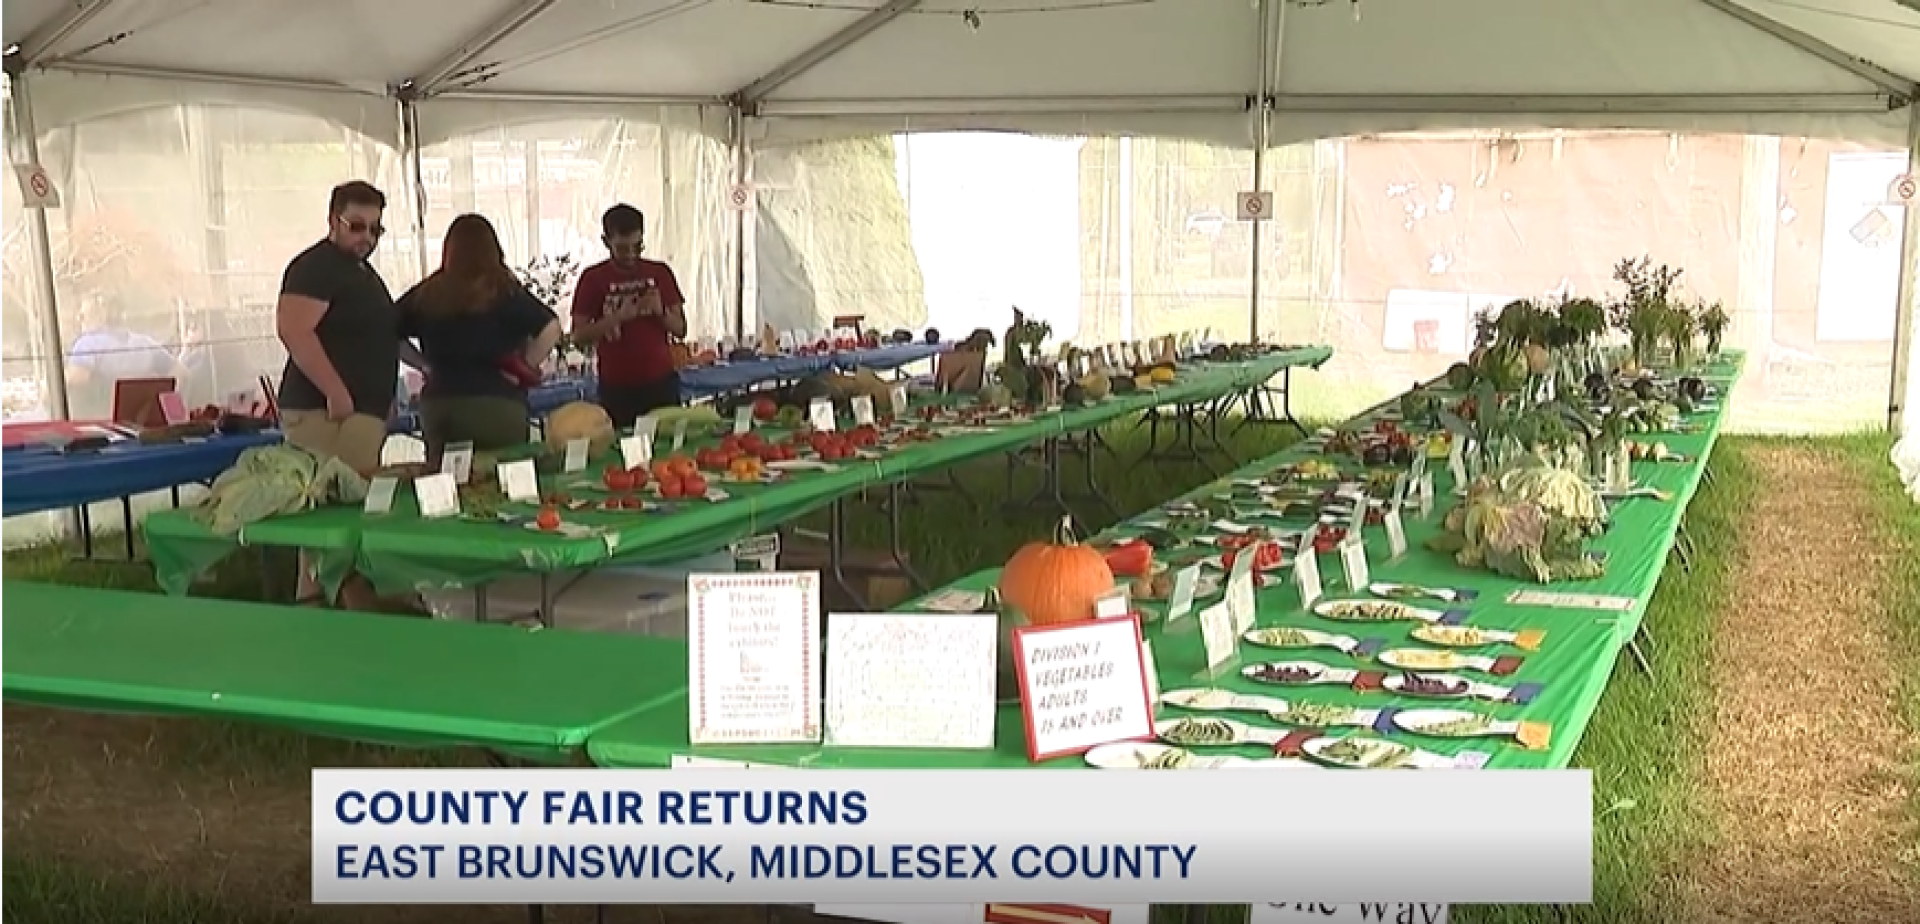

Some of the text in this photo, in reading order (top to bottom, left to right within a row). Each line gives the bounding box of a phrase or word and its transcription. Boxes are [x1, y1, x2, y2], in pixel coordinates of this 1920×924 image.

[1031, 642, 1089, 665] DIVISION
[1035, 661, 1114, 688] VEGETABLES
[1038, 688, 1087, 710] ADULTS
[1058, 711, 1087, 731] AND
[1091, 705, 1123, 727] OVER
